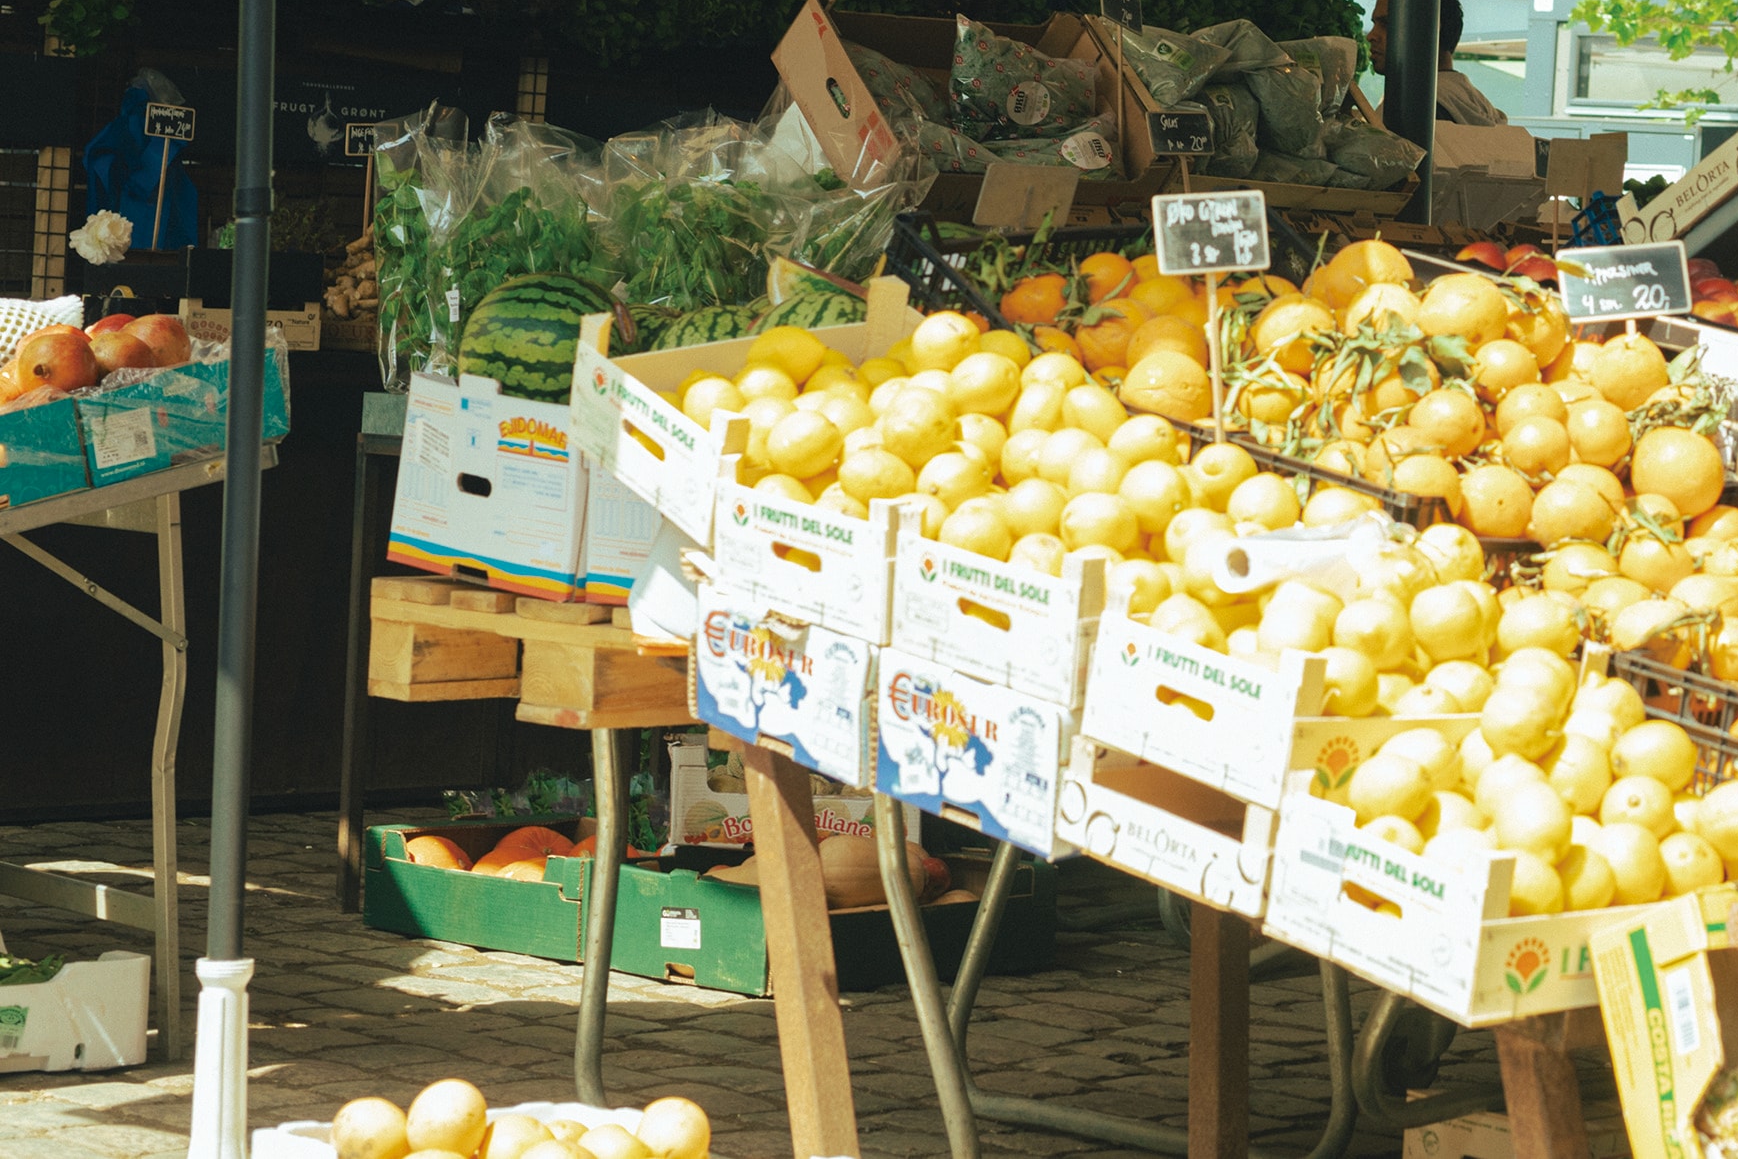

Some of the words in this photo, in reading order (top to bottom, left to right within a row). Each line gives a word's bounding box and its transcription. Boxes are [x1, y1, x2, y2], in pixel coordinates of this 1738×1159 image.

[341, 106, 386, 119] GRØNT
[1581, 294, 1595, 315] 4
[617, 383, 650, 418] FRUTTI
[651, 409, 669, 433] DEL
[671, 423, 695, 451] SOLE
[760, 505, 799, 530] FRUTTI
[801, 517, 822, 537] DEL
[825, 523, 854, 545] SOLE
[950, 562, 991, 587] FRUTTI
[994, 574, 1016, 595] DEL
[1019, 582, 1050, 606] SOLE
[1155, 646, 1200, 677] FRUTTI
[1203, 664, 1225, 687] DEL
[1230, 674, 1262, 700] SOLE
[1384, 859, 1407, 885] DEL
[1411, 872, 1445, 900] SOLE
